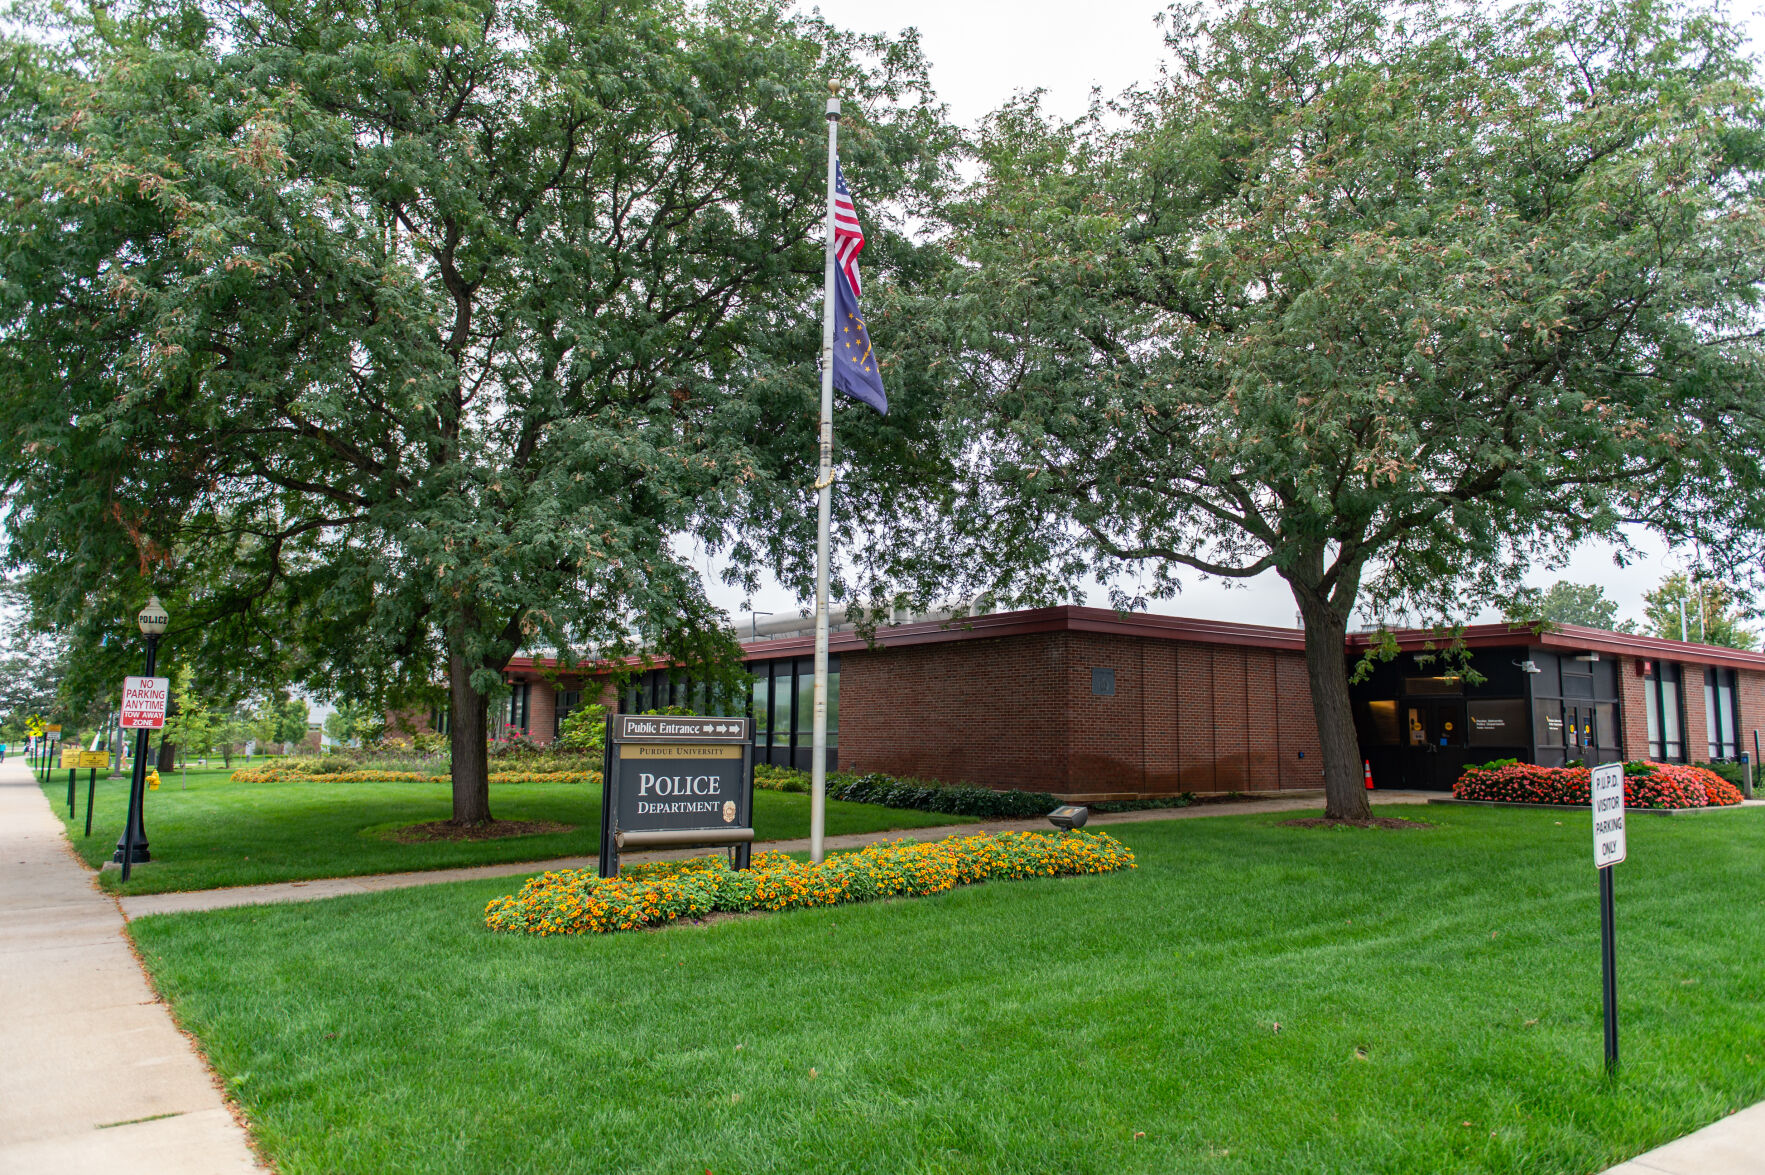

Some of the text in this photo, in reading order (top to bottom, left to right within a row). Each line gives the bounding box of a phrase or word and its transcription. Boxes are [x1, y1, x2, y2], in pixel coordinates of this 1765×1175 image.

[140, 615, 168, 624] POLICE
[140, 680, 154, 689] NO
[126, 690, 165, 700] PARKING
[125, 700, 164, 710] ANYTIME
[142, 711, 163, 719] AWAY
[627, 722, 700, 734] Public Entrance
[639, 747, 724, 755] PURDUE UNIVERSITY
[638, 773, 721, 796] POLICE
[1596, 775, 1619, 790] P.U.P.D.
[637, 801, 720, 814] DEPARTMENT
[1596, 796, 1620, 812] VISITOR
[1596, 817, 1622, 833] PARKING
[1602, 841, 1617, 856] ONLY
